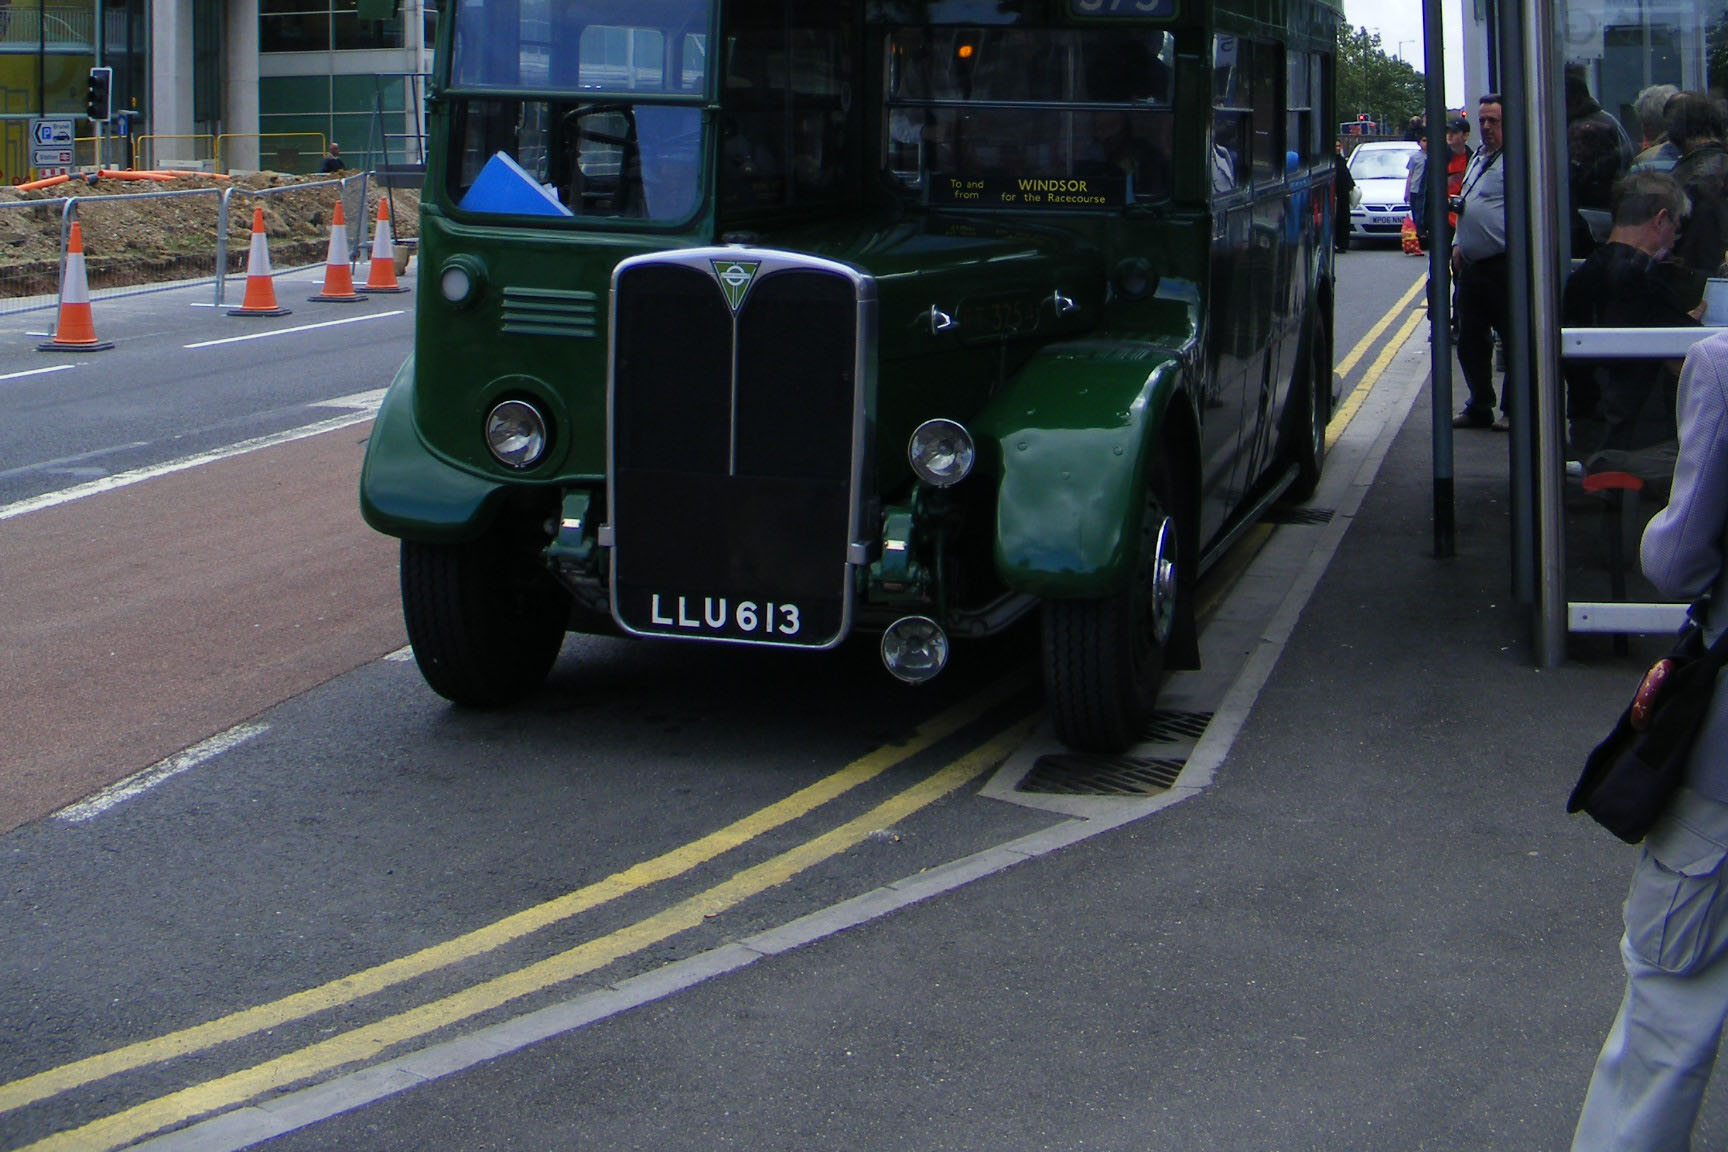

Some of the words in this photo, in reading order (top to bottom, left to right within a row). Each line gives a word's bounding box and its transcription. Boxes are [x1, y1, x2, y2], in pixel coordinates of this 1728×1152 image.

[950, 179, 963, 189] To
[966, 179, 985, 189] and
[1018, 178, 1088, 193] WINDSOR
[954, 189, 980, 200] from
[1000, 191, 1018, 203] for
[1024, 191, 1042, 203] the
[1047, 192, 1107, 204] Racecourse
